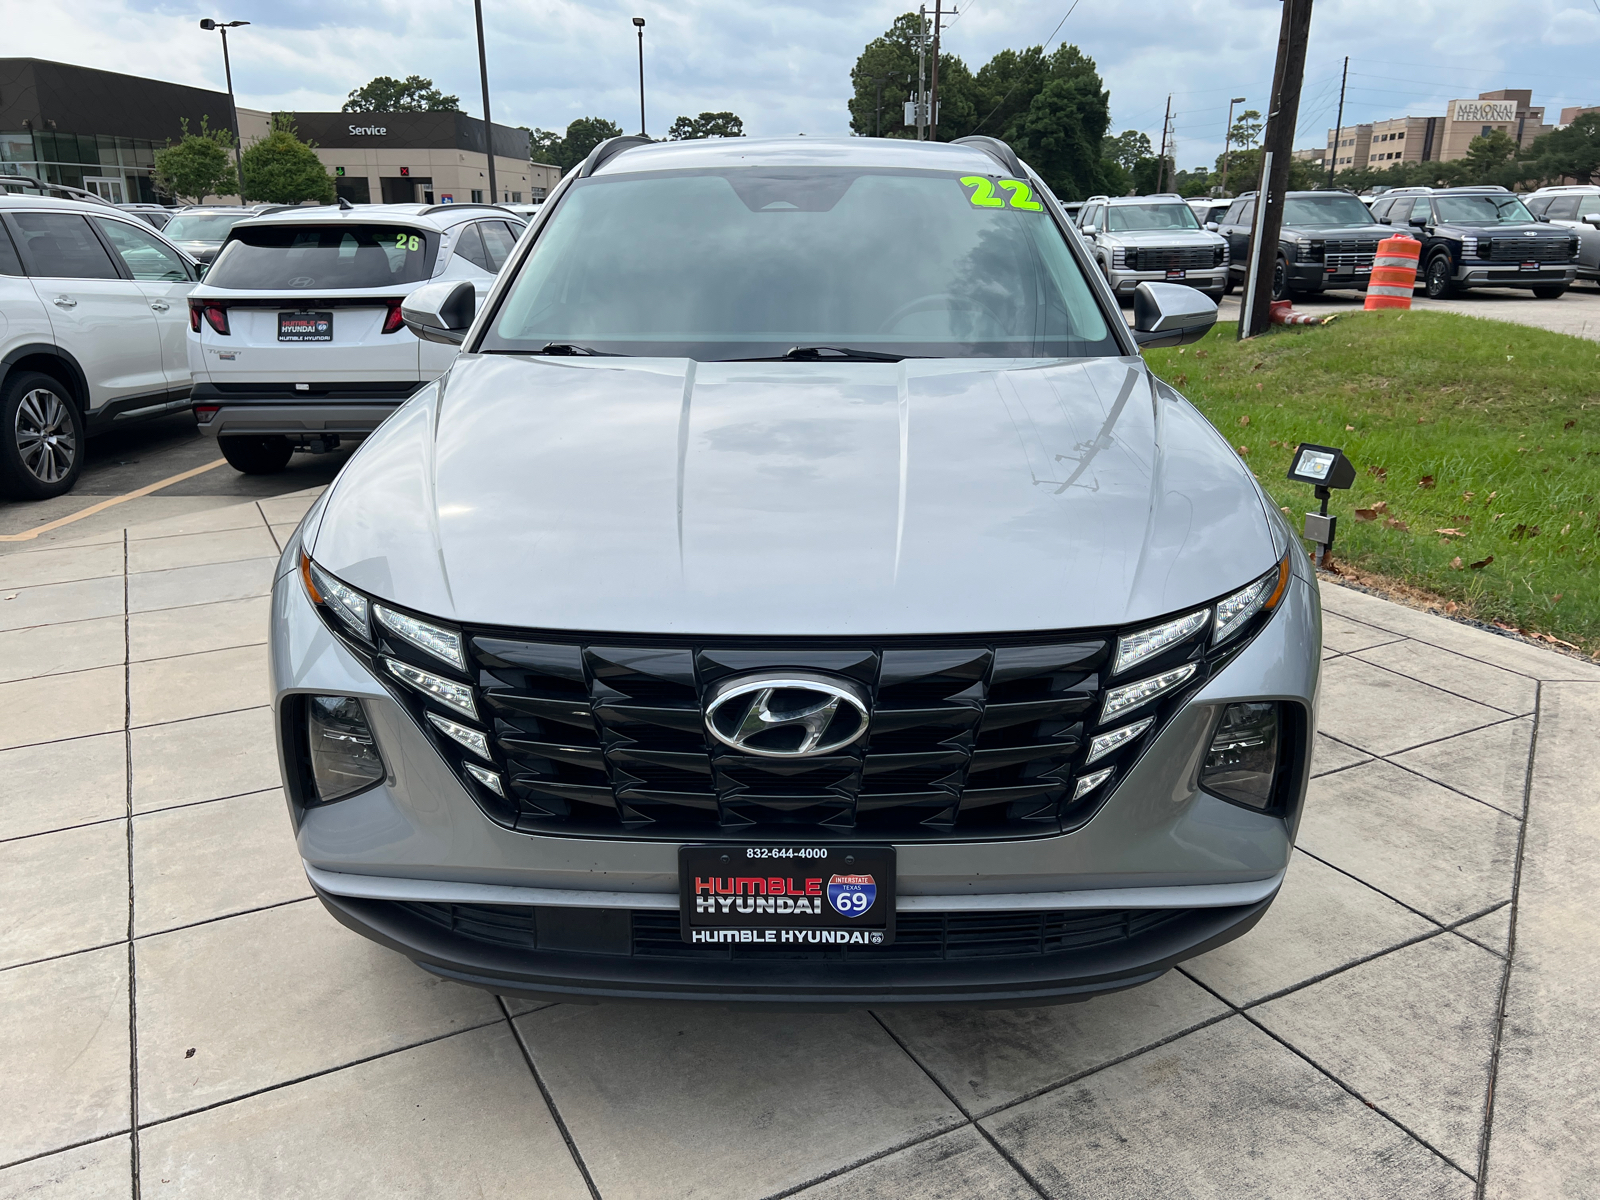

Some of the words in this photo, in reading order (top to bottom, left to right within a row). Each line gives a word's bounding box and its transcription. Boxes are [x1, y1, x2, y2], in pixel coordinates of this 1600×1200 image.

[1456, 112, 1513, 121] HERMANN
[1458, 103, 1514, 114] MEMORIAL
[348, 124, 387, 136] Service
[960, 176, 1044, 212] 22
[395, 233, 420, 252] 26
[746, 848, 828, 859] 832-644-4000
[695, 876, 823, 896] HUMBLE
[696, 896, 822, 914] HYUNDAI
[836, 892, 868, 911] 69
[692, 930, 777, 943] HUMBLE
[781, 930, 869, 944] HYUNDAI
